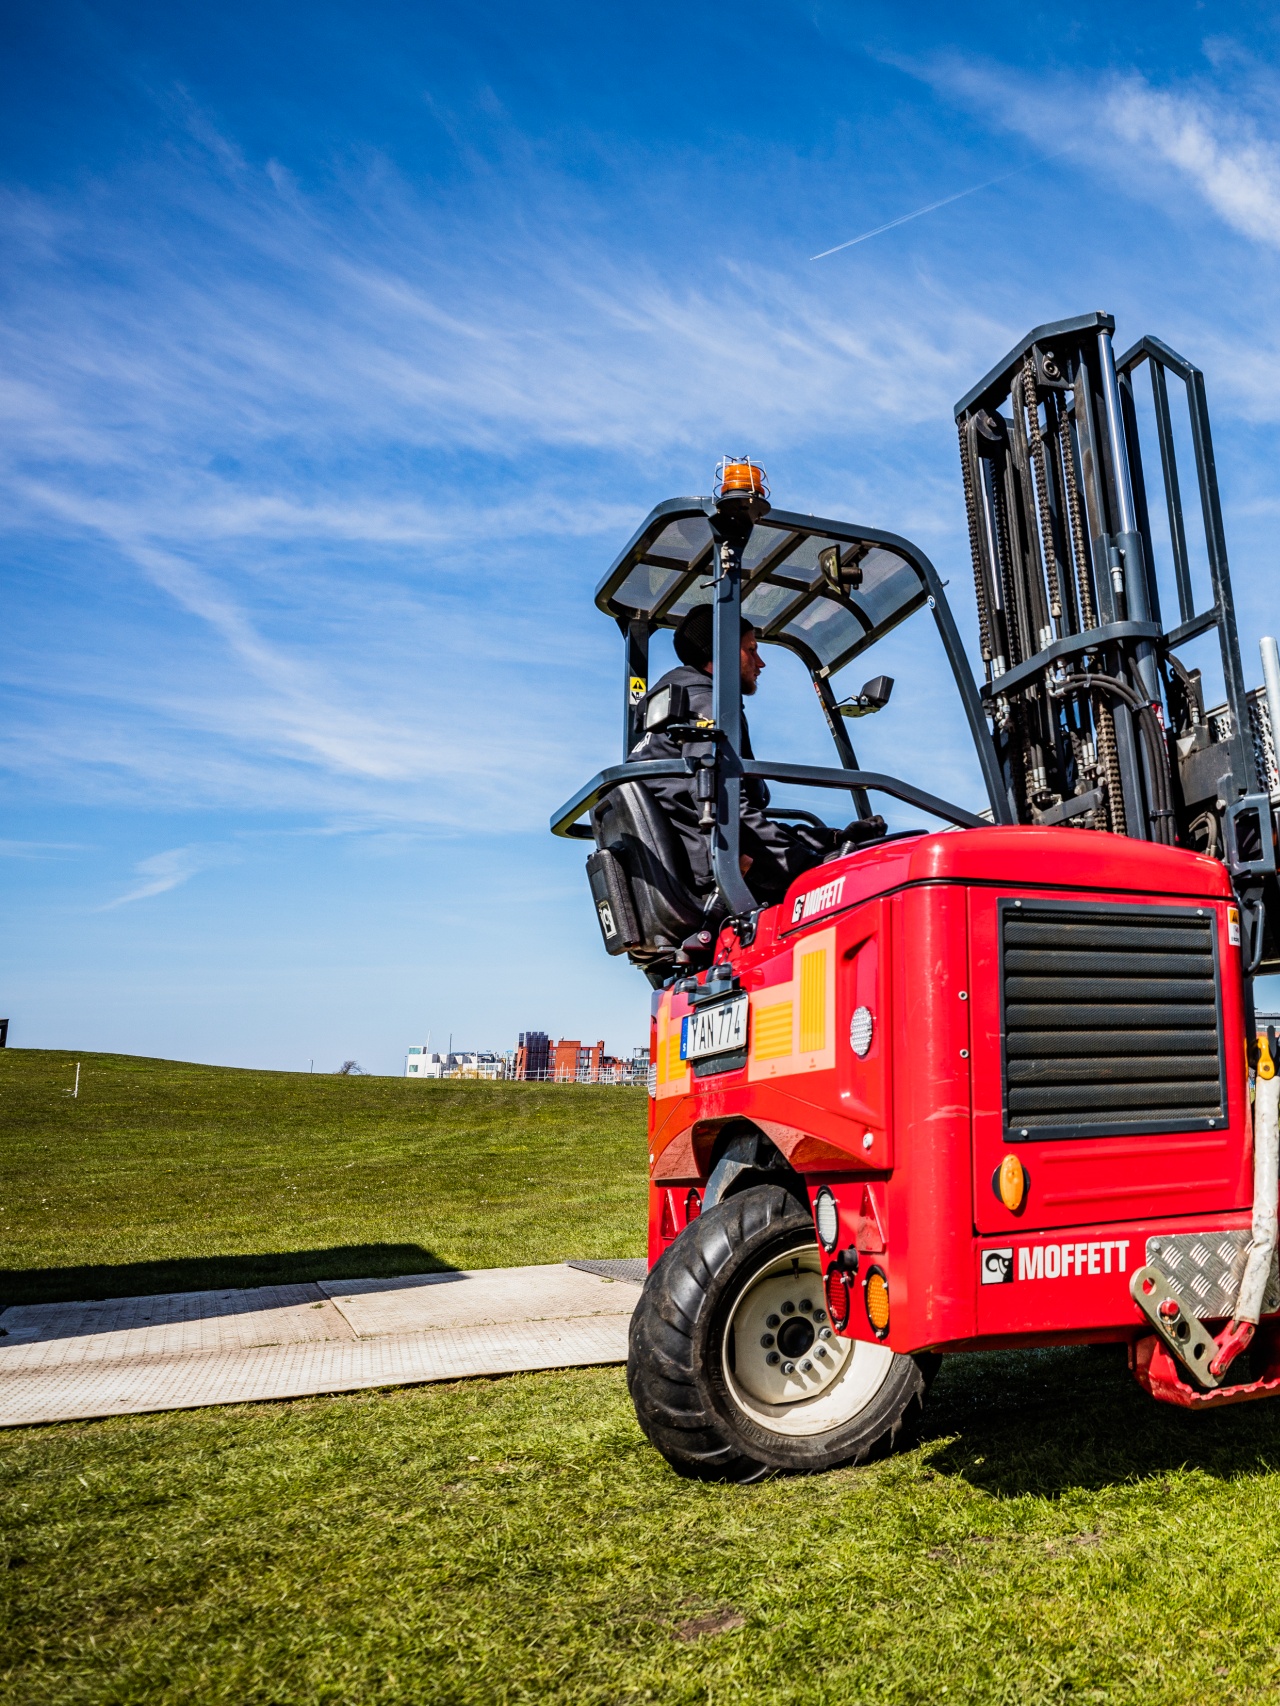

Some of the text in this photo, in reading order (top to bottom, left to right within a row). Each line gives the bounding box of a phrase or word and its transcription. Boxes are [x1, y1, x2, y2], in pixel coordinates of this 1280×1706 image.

[803, 876, 846, 919] MOFFETT
[691, 1004, 741, 1052] YAN 774
[1018, 1240, 1130, 1281] MOFFETT
